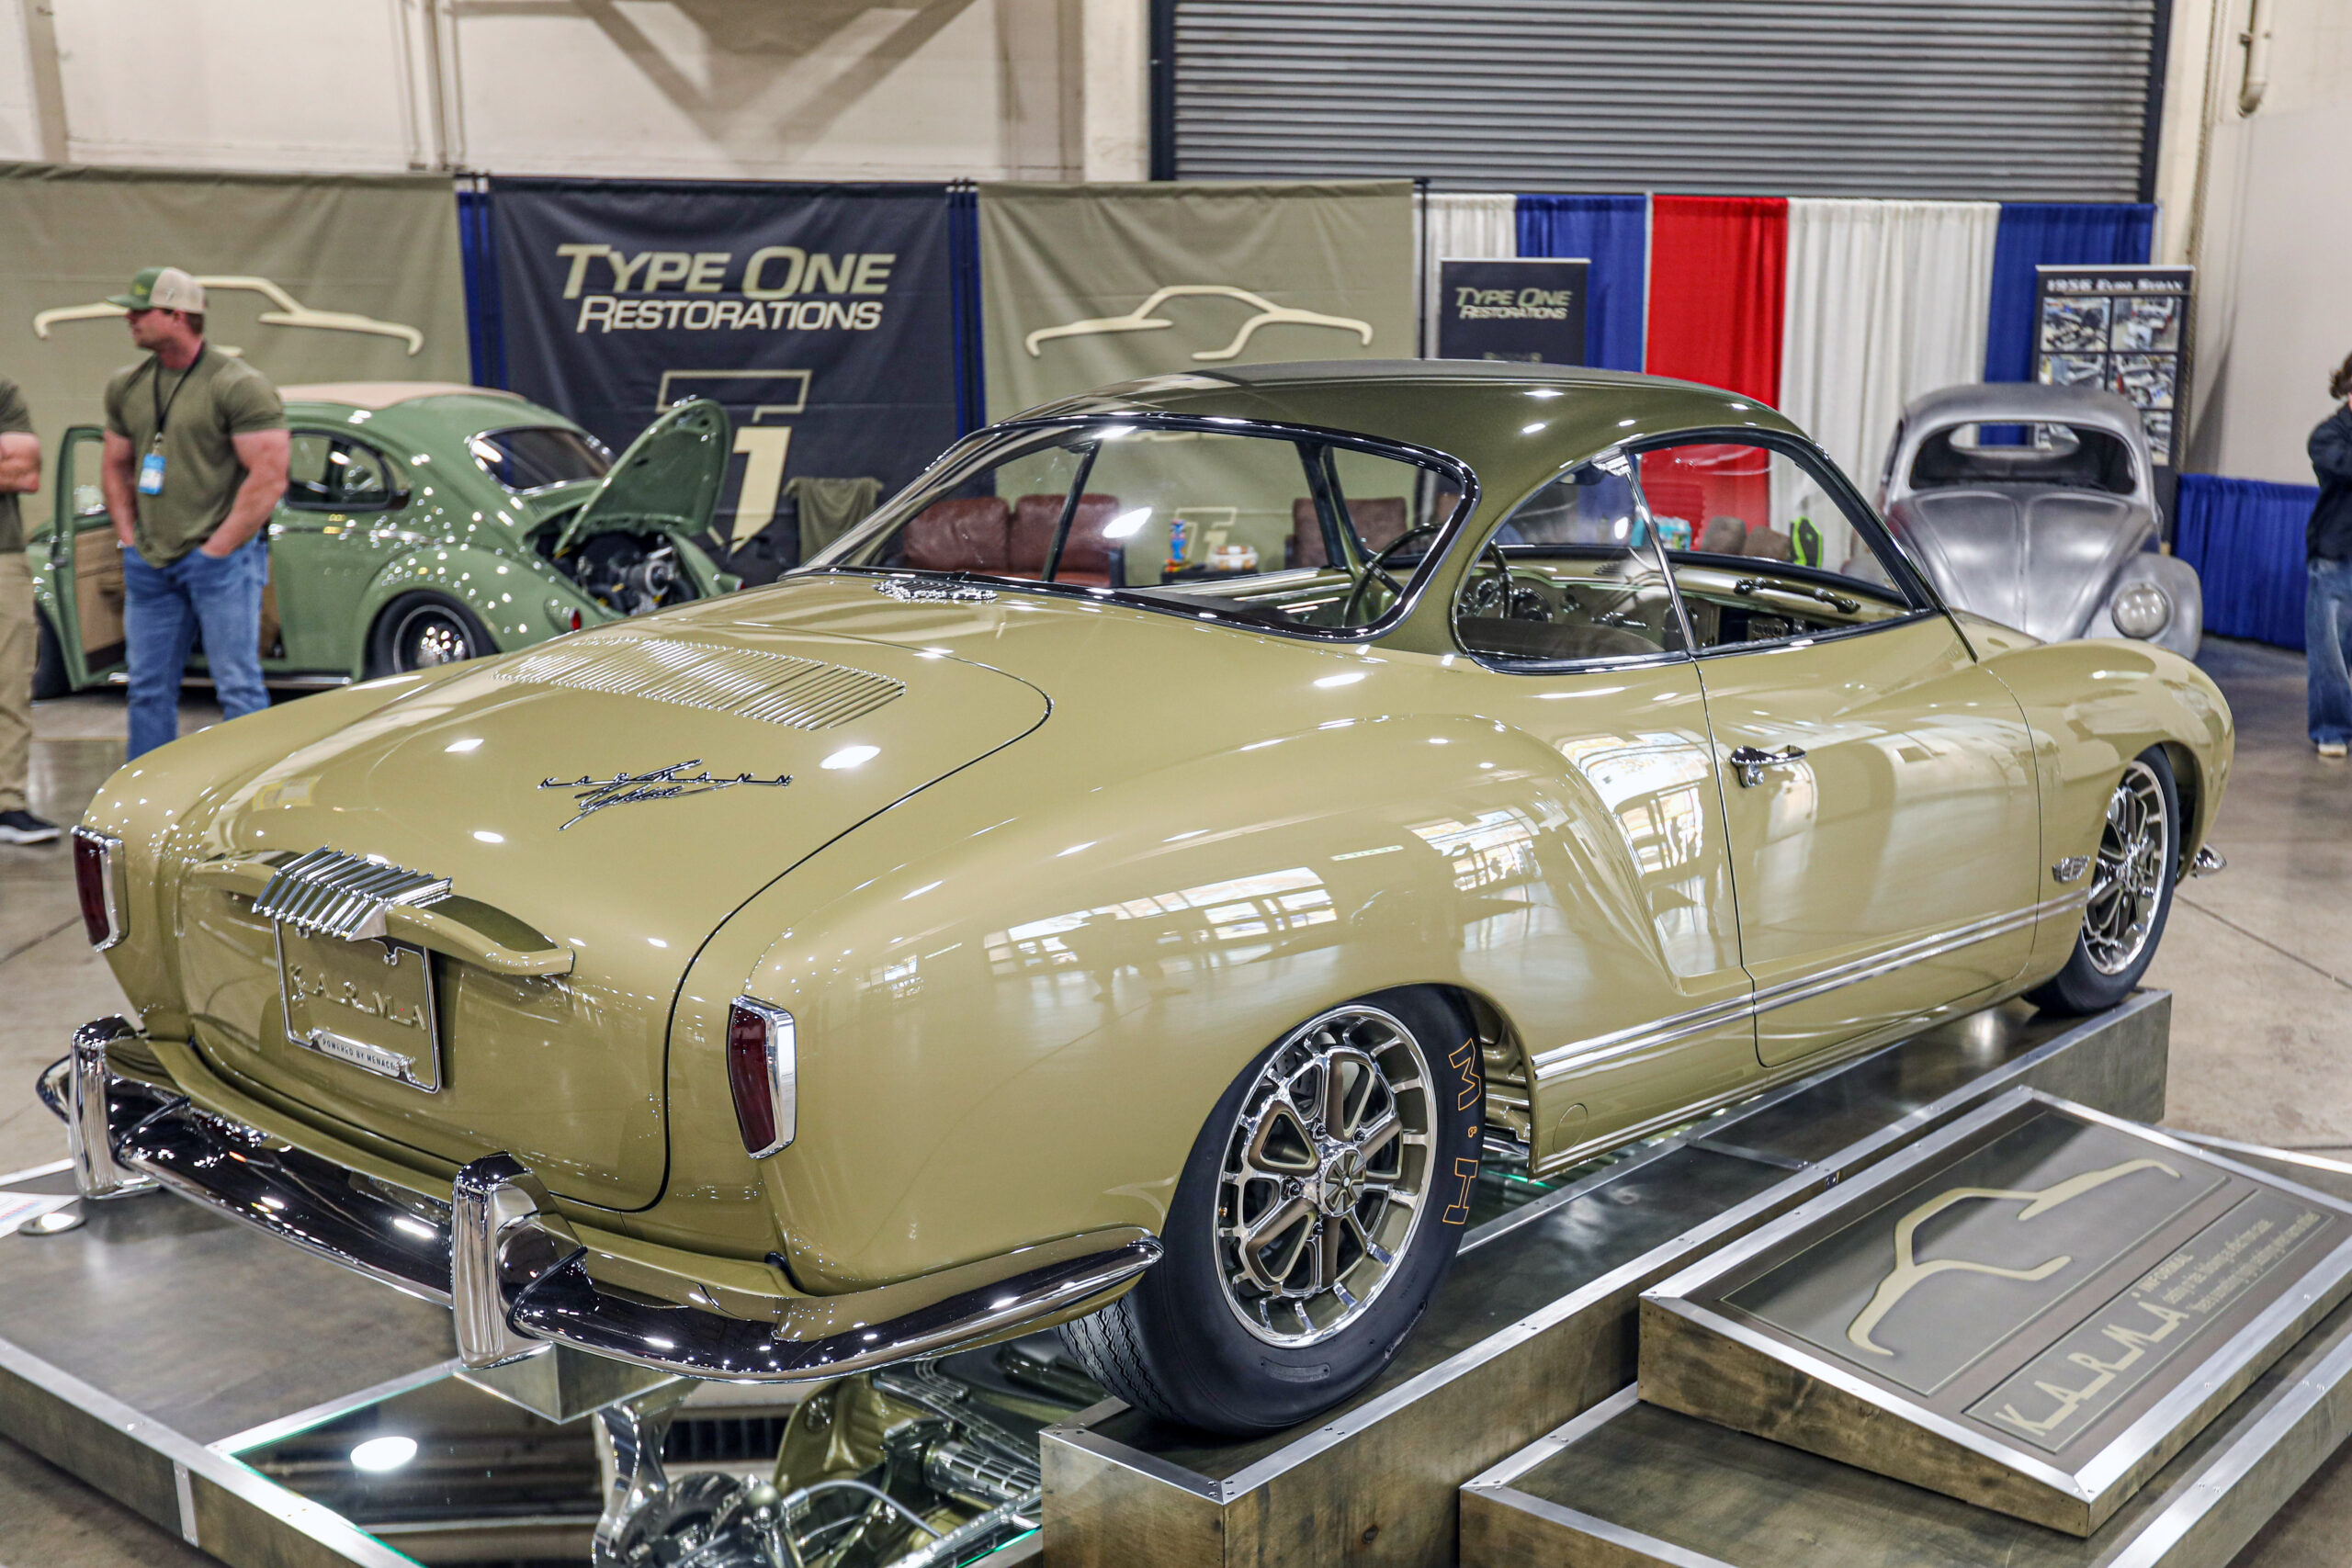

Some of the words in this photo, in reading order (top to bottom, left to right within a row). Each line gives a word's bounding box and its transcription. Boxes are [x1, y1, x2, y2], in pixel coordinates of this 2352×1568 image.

[556, 243, 732, 299] TYPE
[741, 245, 897, 300] ONE
[1455, 287, 1516, 307] TYPE
[1517, 287, 1573, 308] ONE
[1459, 304, 1568, 320] RESTORATIONS
[576, 295, 884, 333] RESTORATIONS
